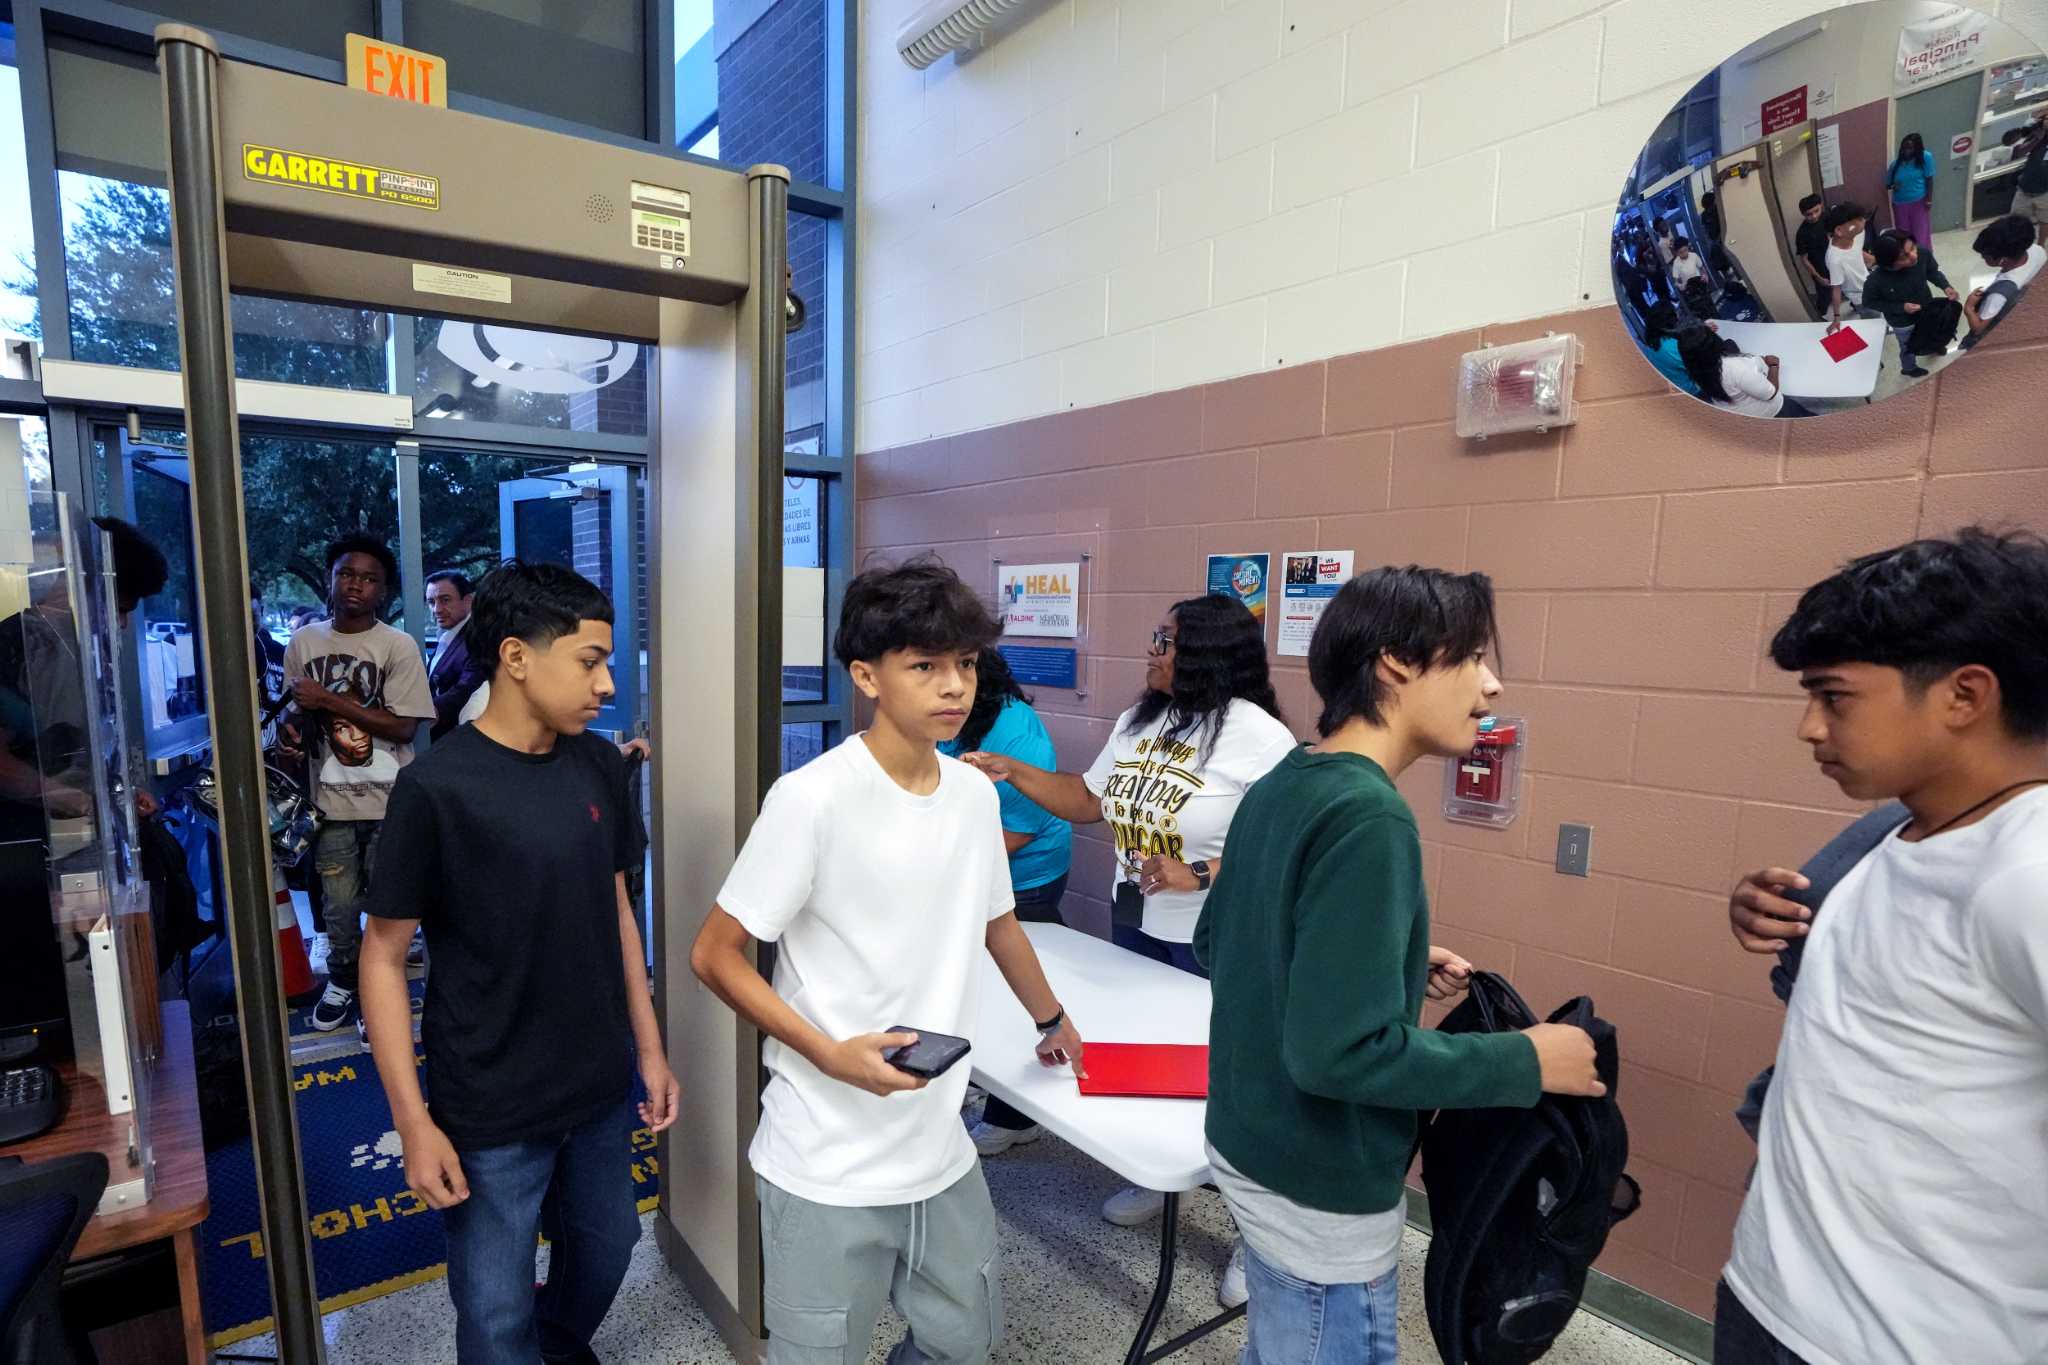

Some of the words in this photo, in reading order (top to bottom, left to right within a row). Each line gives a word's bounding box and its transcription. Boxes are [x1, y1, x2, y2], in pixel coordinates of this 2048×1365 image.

[365, 45, 434, 105] EXIT
[247, 150, 379, 193] GARRETT
[446, 270, 479, 280] CAUTION
[13, 341, 34, 380] 1
[1026, 574, 1072, 595] HEAL
[1320, 564, 1338, 572] WANT
[1104, 773, 1153, 802] REAT
[1146, 779, 1194, 815] DAY
[1111, 819, 1185, 864] OUGAR
